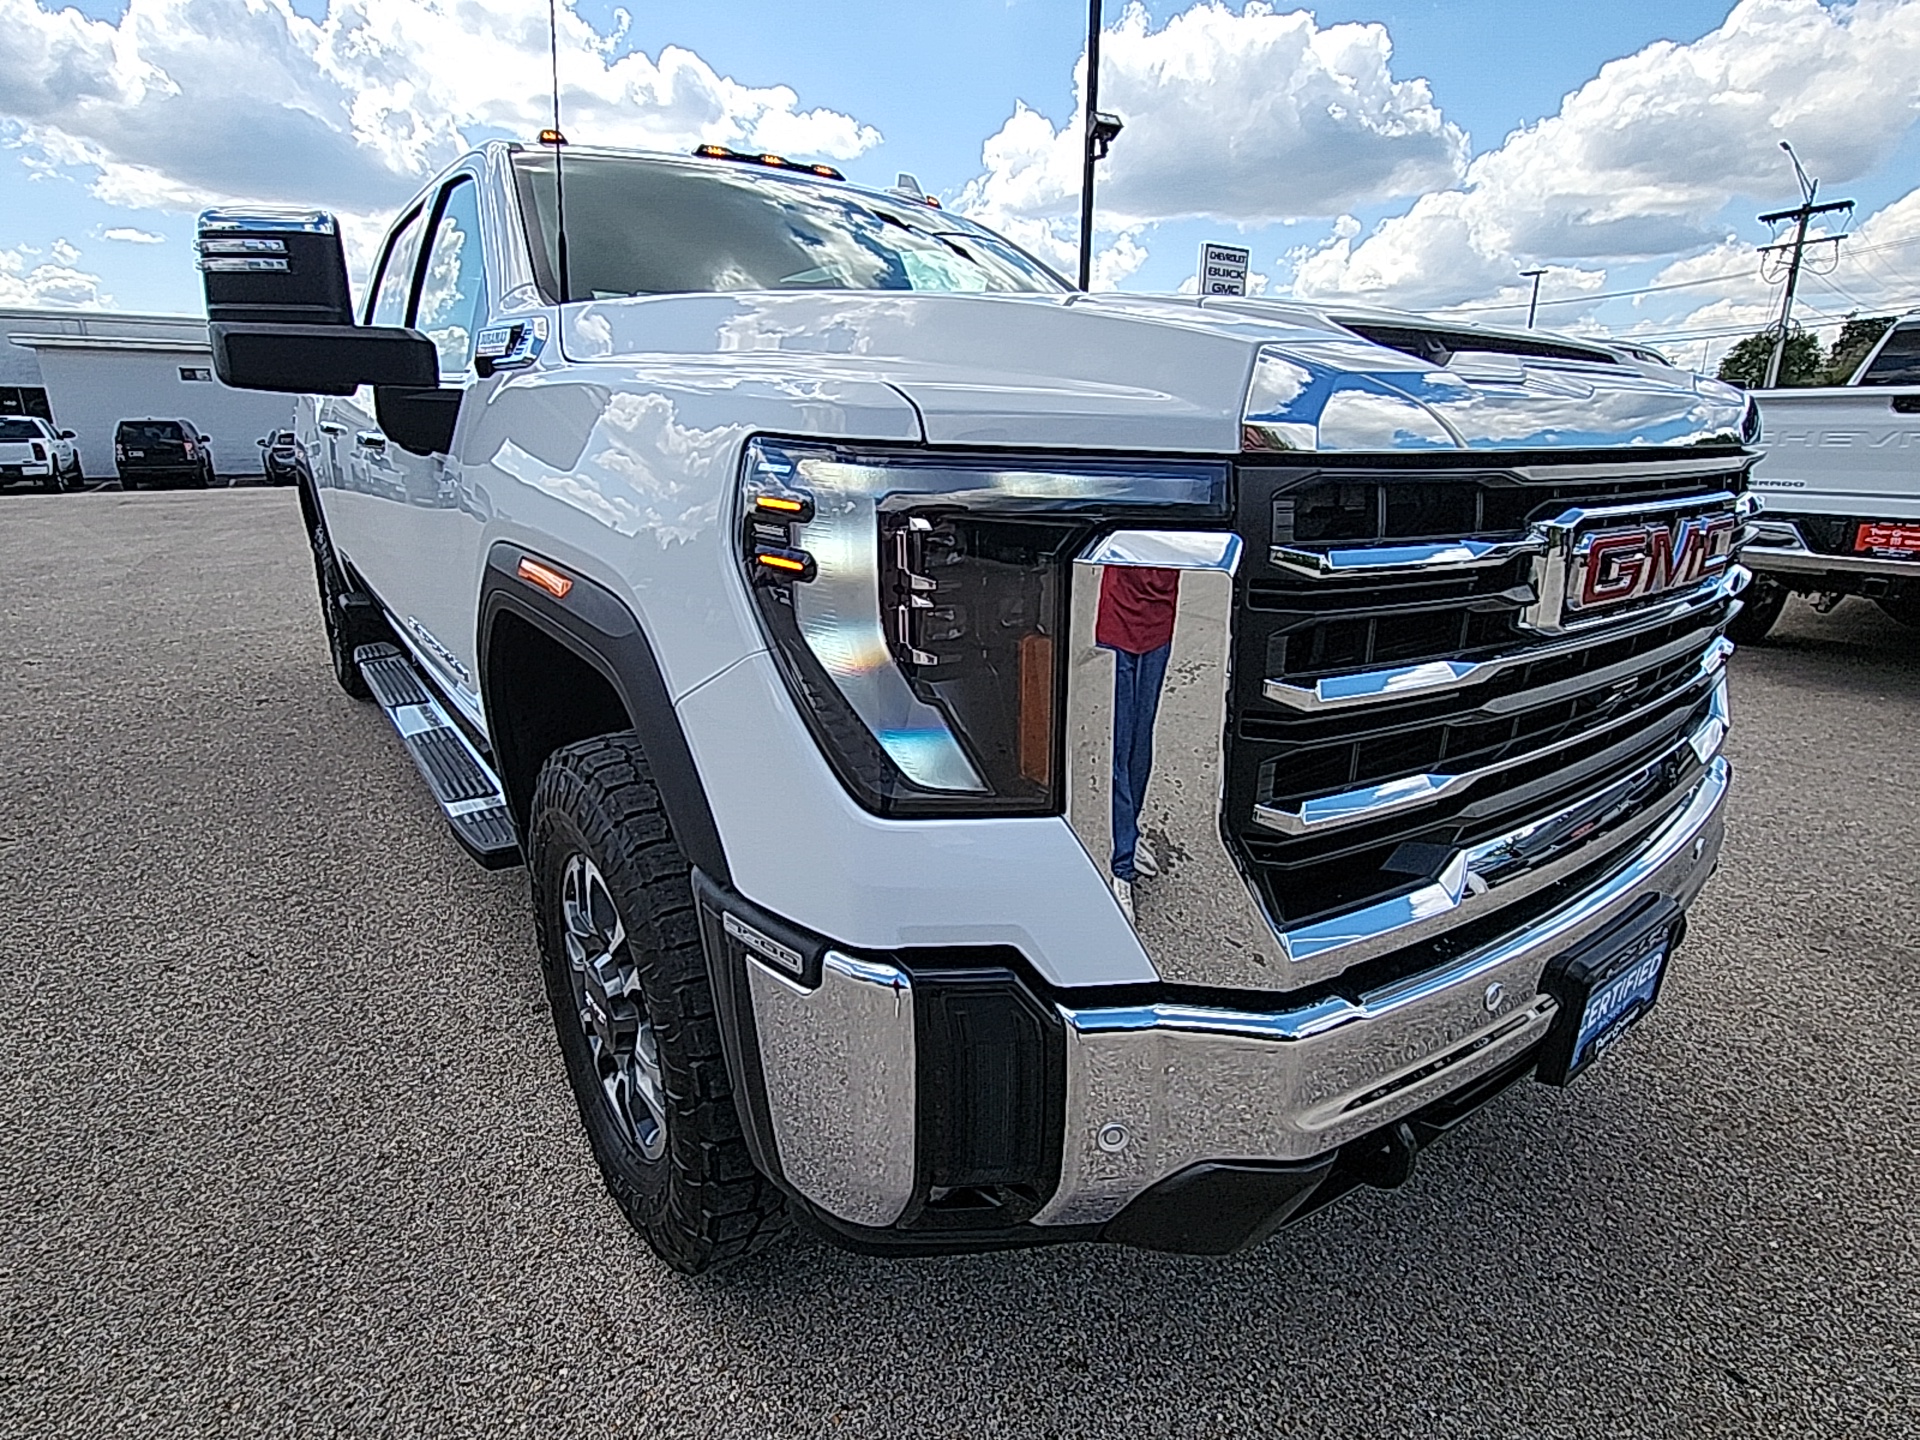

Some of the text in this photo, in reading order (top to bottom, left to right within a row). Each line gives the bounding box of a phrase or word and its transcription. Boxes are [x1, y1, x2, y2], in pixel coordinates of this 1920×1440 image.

[1208, 266, 1245, 279] BUICK
[1211, 282, 1240, 296] GMC
[1574, 514, 1735, 607] GMC
[1579, 952, 1663, 1037] CERTIFIED
